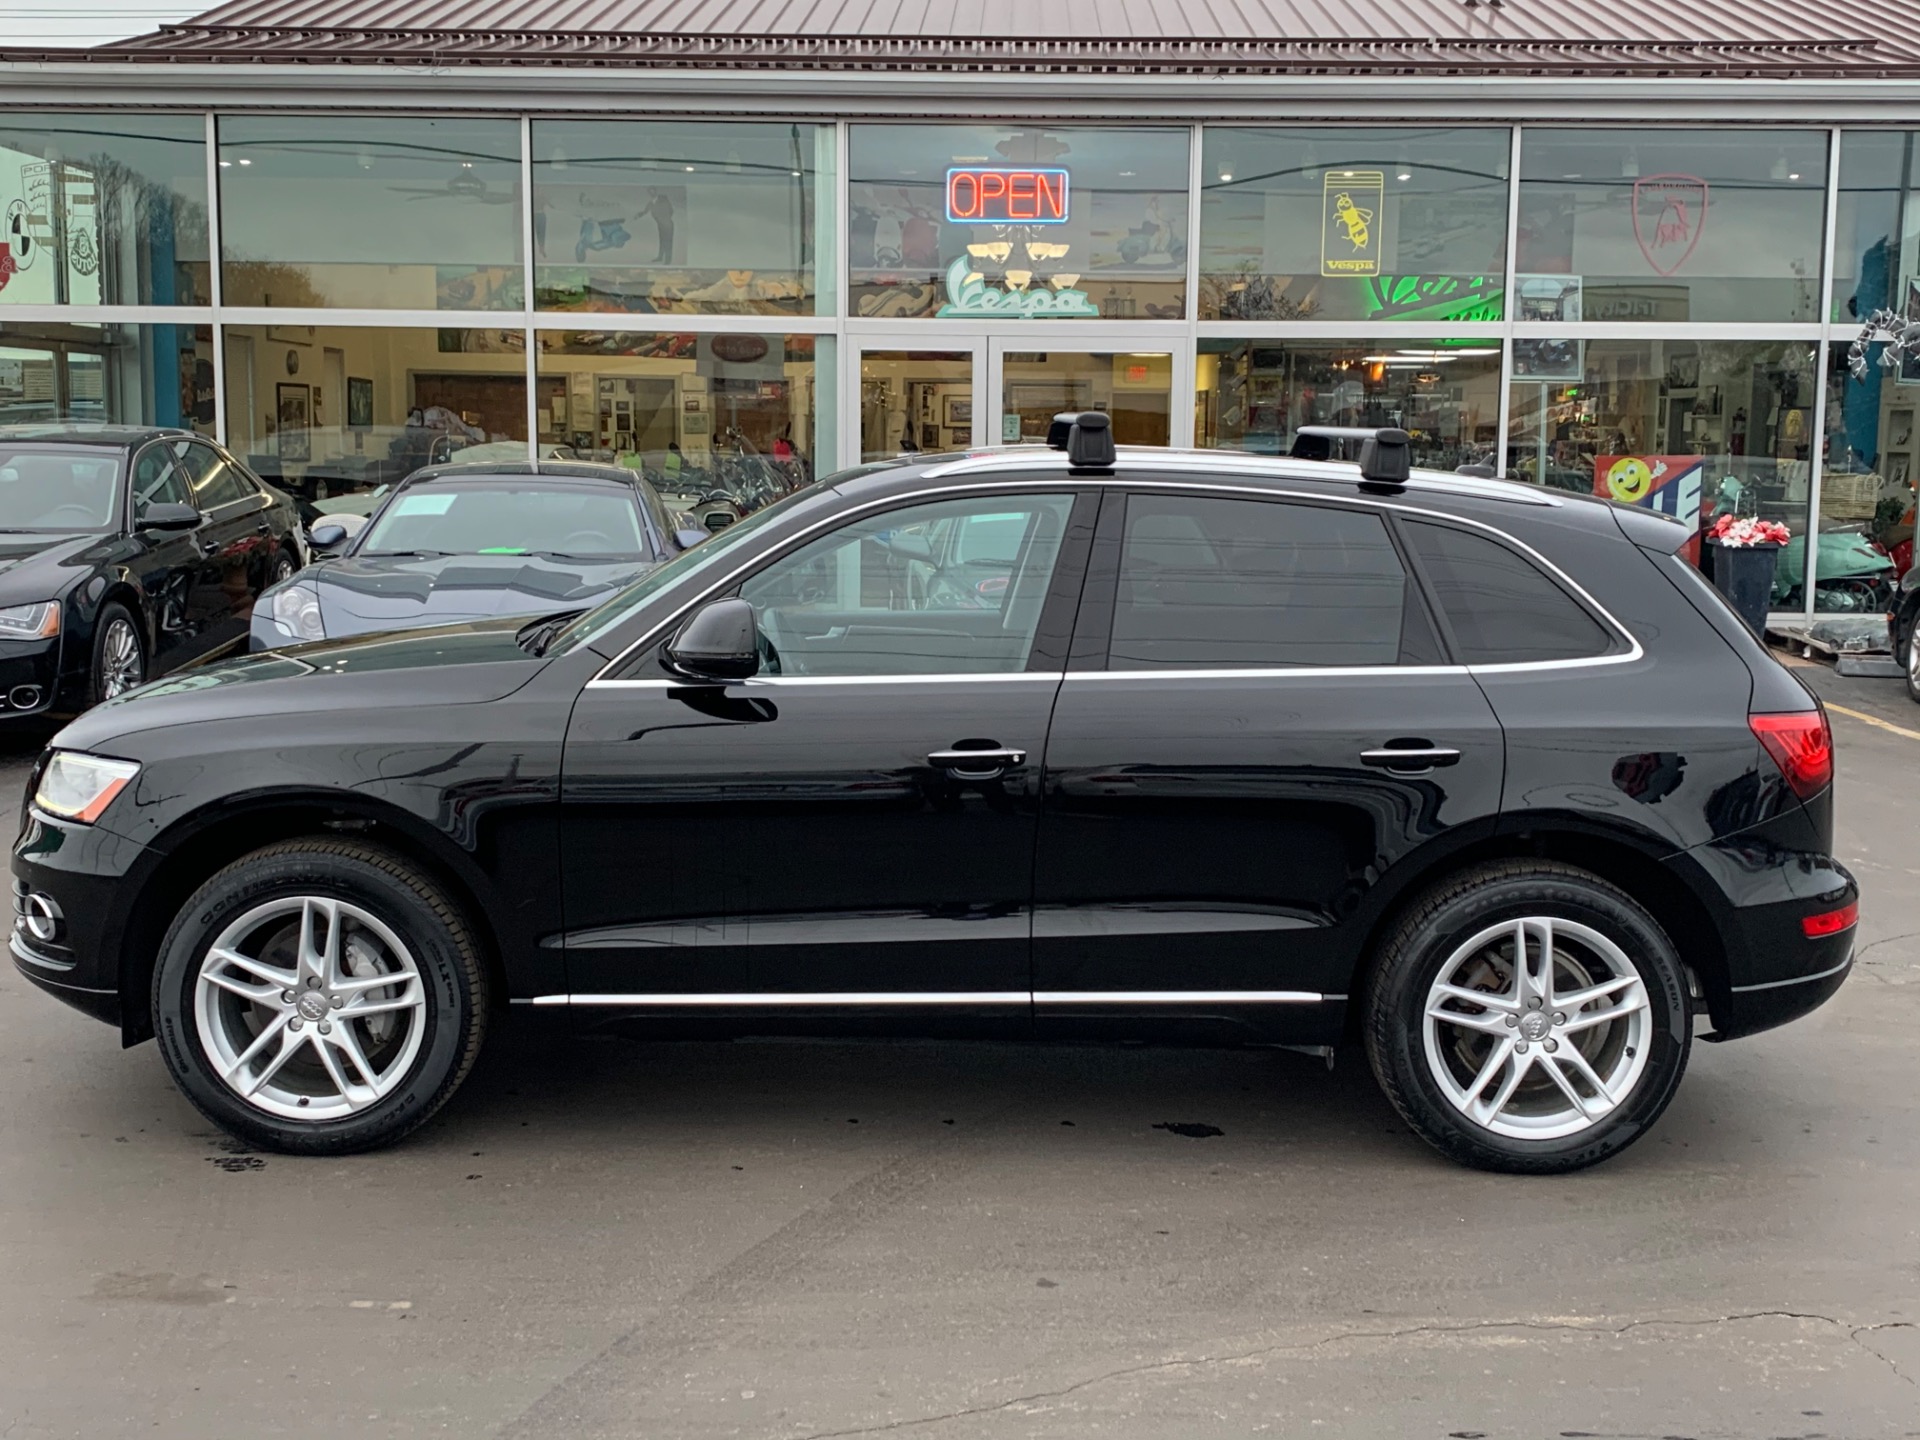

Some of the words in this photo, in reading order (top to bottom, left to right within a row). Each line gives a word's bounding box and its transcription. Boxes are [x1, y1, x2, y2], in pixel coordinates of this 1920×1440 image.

[951, 173, 1063, 218] OPEN
[940, 255, 1097, 319] Vespa
[1326, 260, 1375, 272] Vespa
